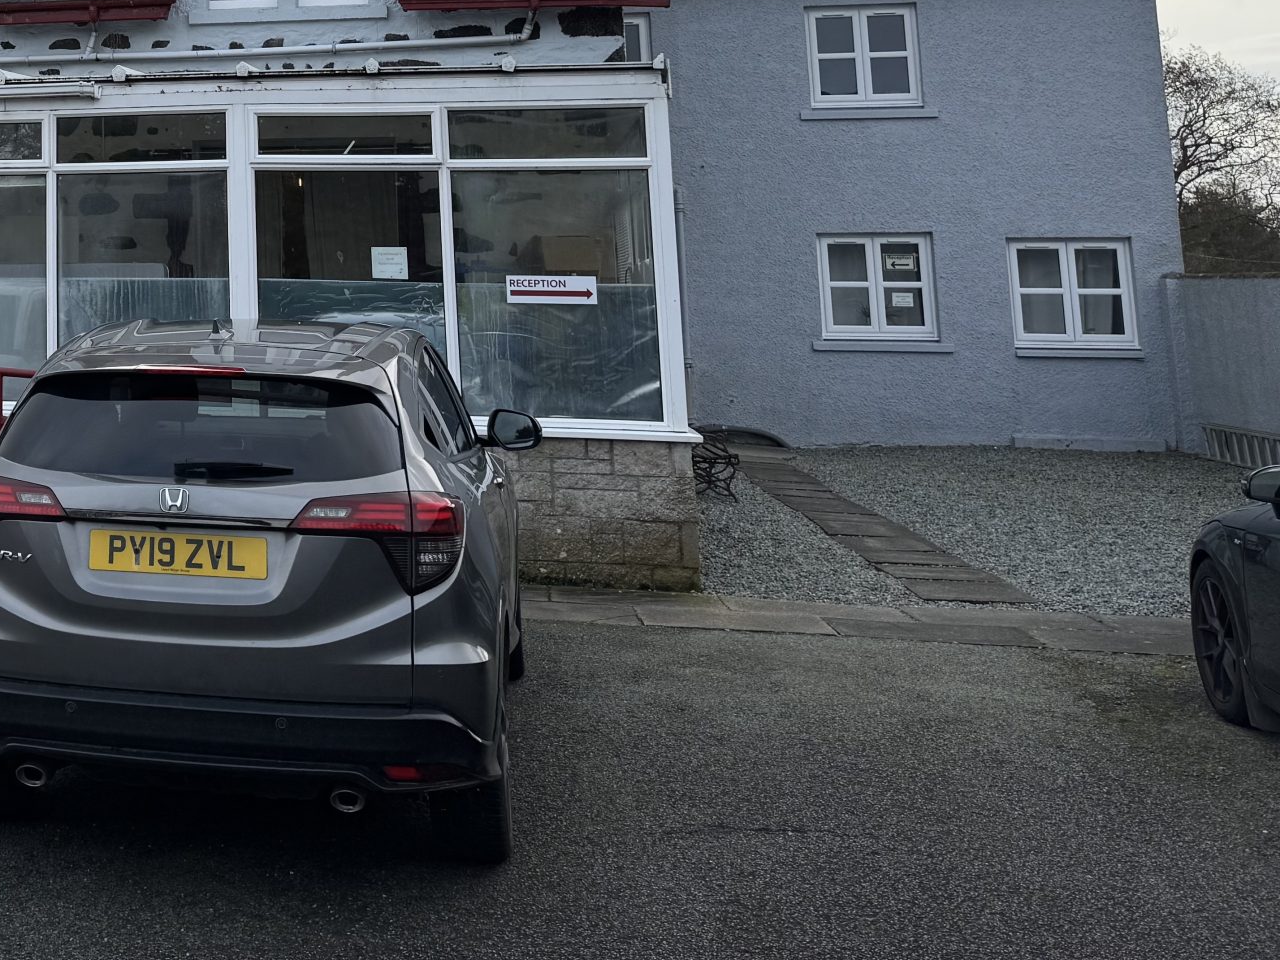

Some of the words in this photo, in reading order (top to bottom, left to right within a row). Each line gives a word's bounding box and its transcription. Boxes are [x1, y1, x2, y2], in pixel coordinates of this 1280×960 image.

[509, 279, 566, 288] RECEPTION
[108, 534, 176, 568] PY19
[185, 538, 246, 572] ZVL
